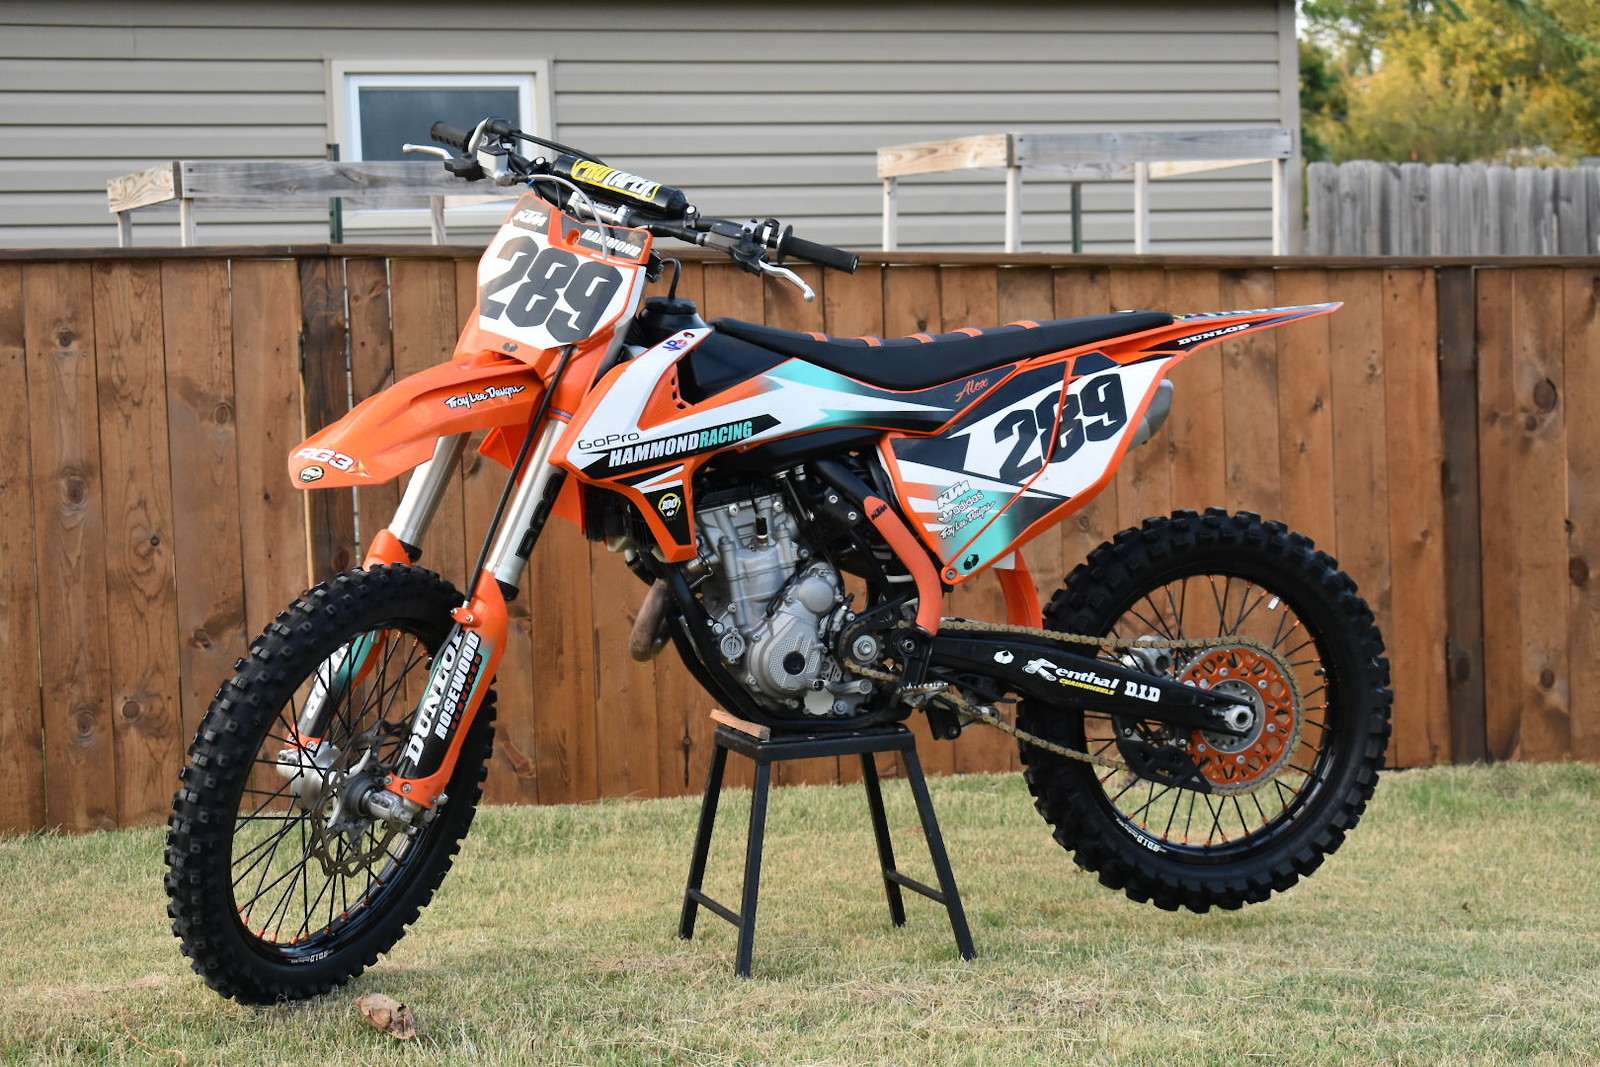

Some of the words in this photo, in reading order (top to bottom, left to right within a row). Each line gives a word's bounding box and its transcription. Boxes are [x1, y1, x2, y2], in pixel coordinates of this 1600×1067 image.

[513, 209, 547, 227] KTM
[480, 236, 623, 343] 289
[1177, 323, 1250, 345] DUNLOP
[445, 396, 471, 409] Troy
[467, 392, 488, 403] Lee
[954, 378, 989, 402] Alex
[578, 432, 640, 450] GoPro
[994, 373, 1127, 485] 289
[937, 480, 971, 510] KTM
[952, 490, 984, 515] adidas
[434, 631, 480, 741] ROSEWOOD
